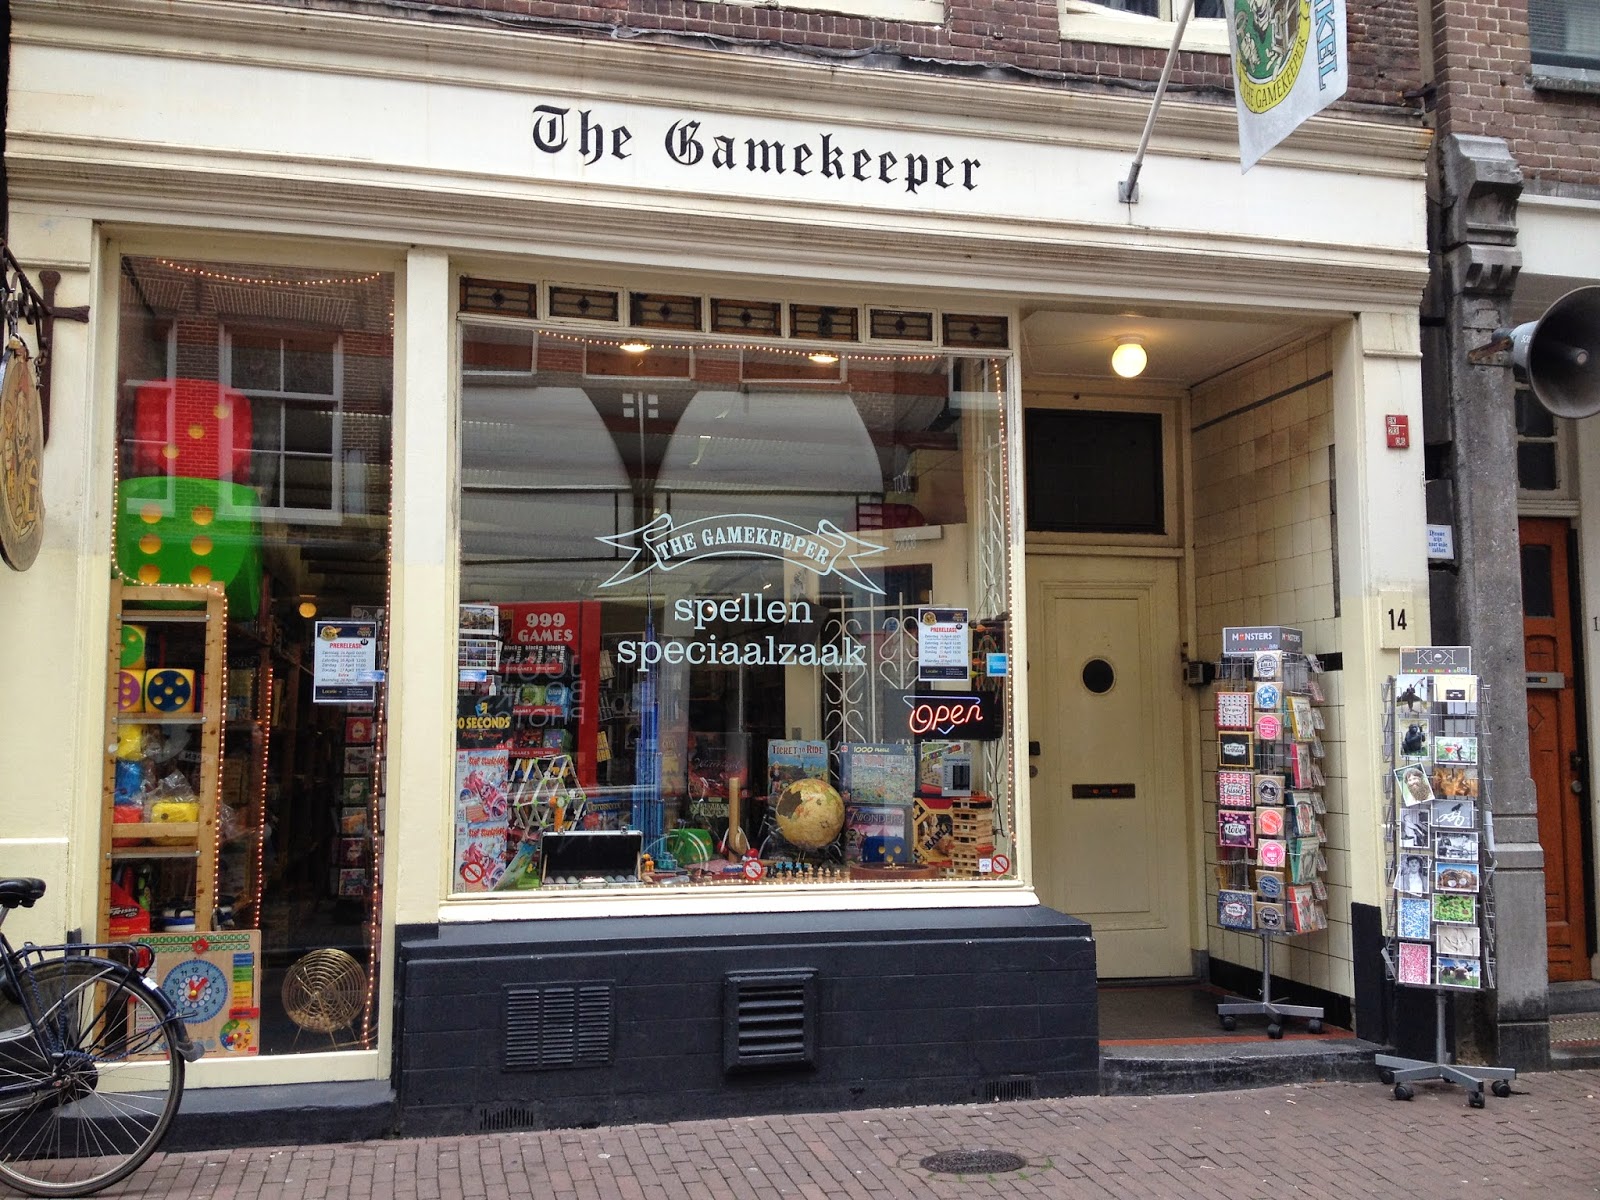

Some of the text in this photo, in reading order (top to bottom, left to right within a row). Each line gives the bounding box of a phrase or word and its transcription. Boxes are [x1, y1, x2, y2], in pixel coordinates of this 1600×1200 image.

[1313, 0, 1338, 91] KEL
[1256, 36, 1308, 109] GAMEKEEPER
[532, 104, 983, 195] The Gamekeeper
[656, 526, 830, 565] THE GAMEKEEPER
[526, 612, 566, 628] 999
[674, 593, 814, 630] spellen
[1388, 608, 1407, 630] 14
[518, 629, 573, 642] GAMES
[617, 635, 867, 672] speciaalzaak
[457, 716, 512, 729] 0 SECONDS
[909, 704, 984, 734] Open
[772, 744, 798, 754] TICKET
[807, 745, 823, 754] RIDE
[856, 814, 904, 824] WONDERS
[1227, 825, 1244, 834] love
